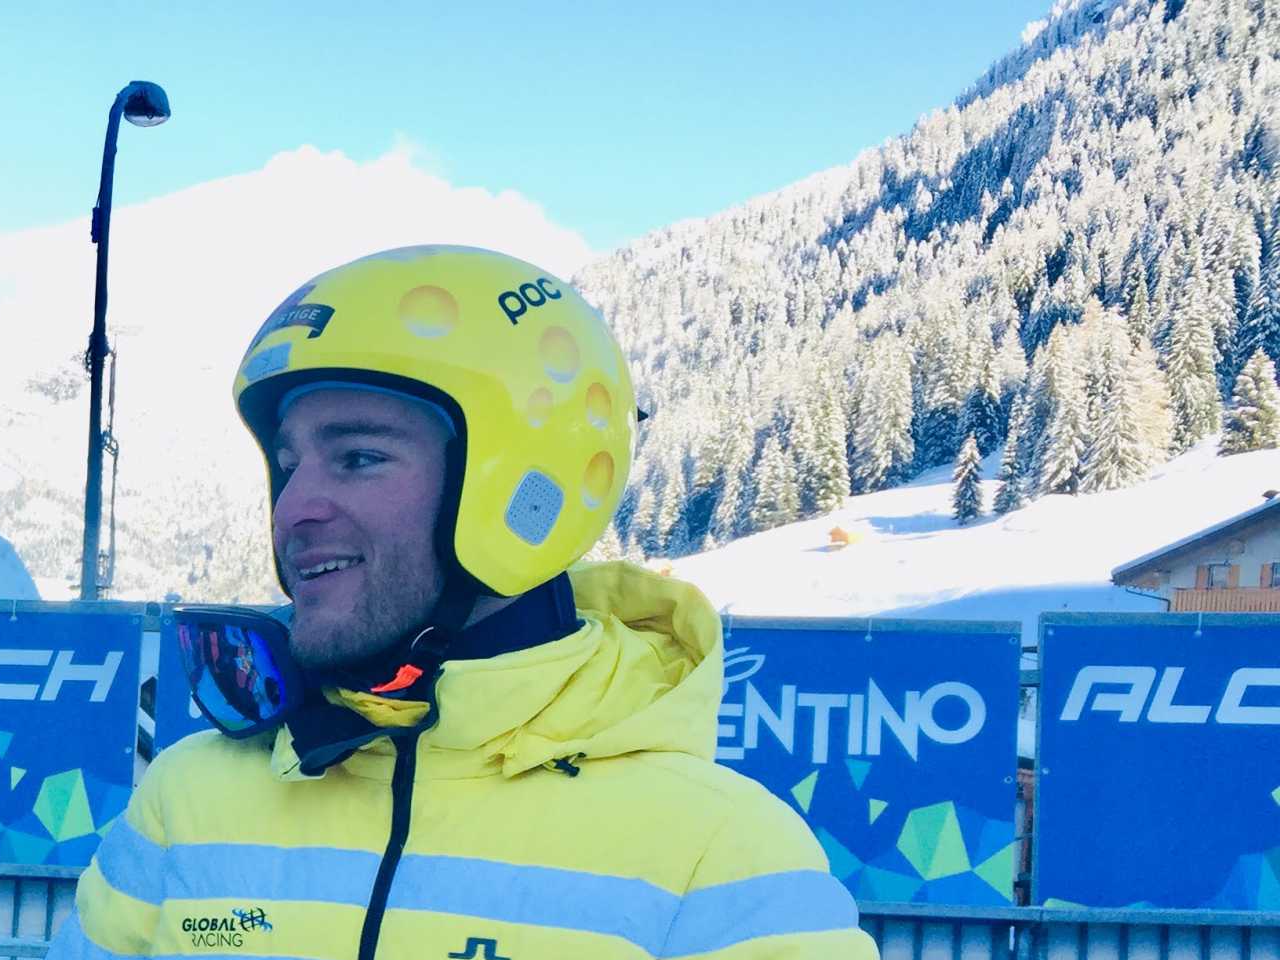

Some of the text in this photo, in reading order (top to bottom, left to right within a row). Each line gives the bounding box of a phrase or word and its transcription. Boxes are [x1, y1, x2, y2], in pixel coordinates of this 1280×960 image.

[716, 677, 987, 763] ENTINO
[182, 918, 236, 932] GLOBAL
[191, 932, 244, 948] RACING
